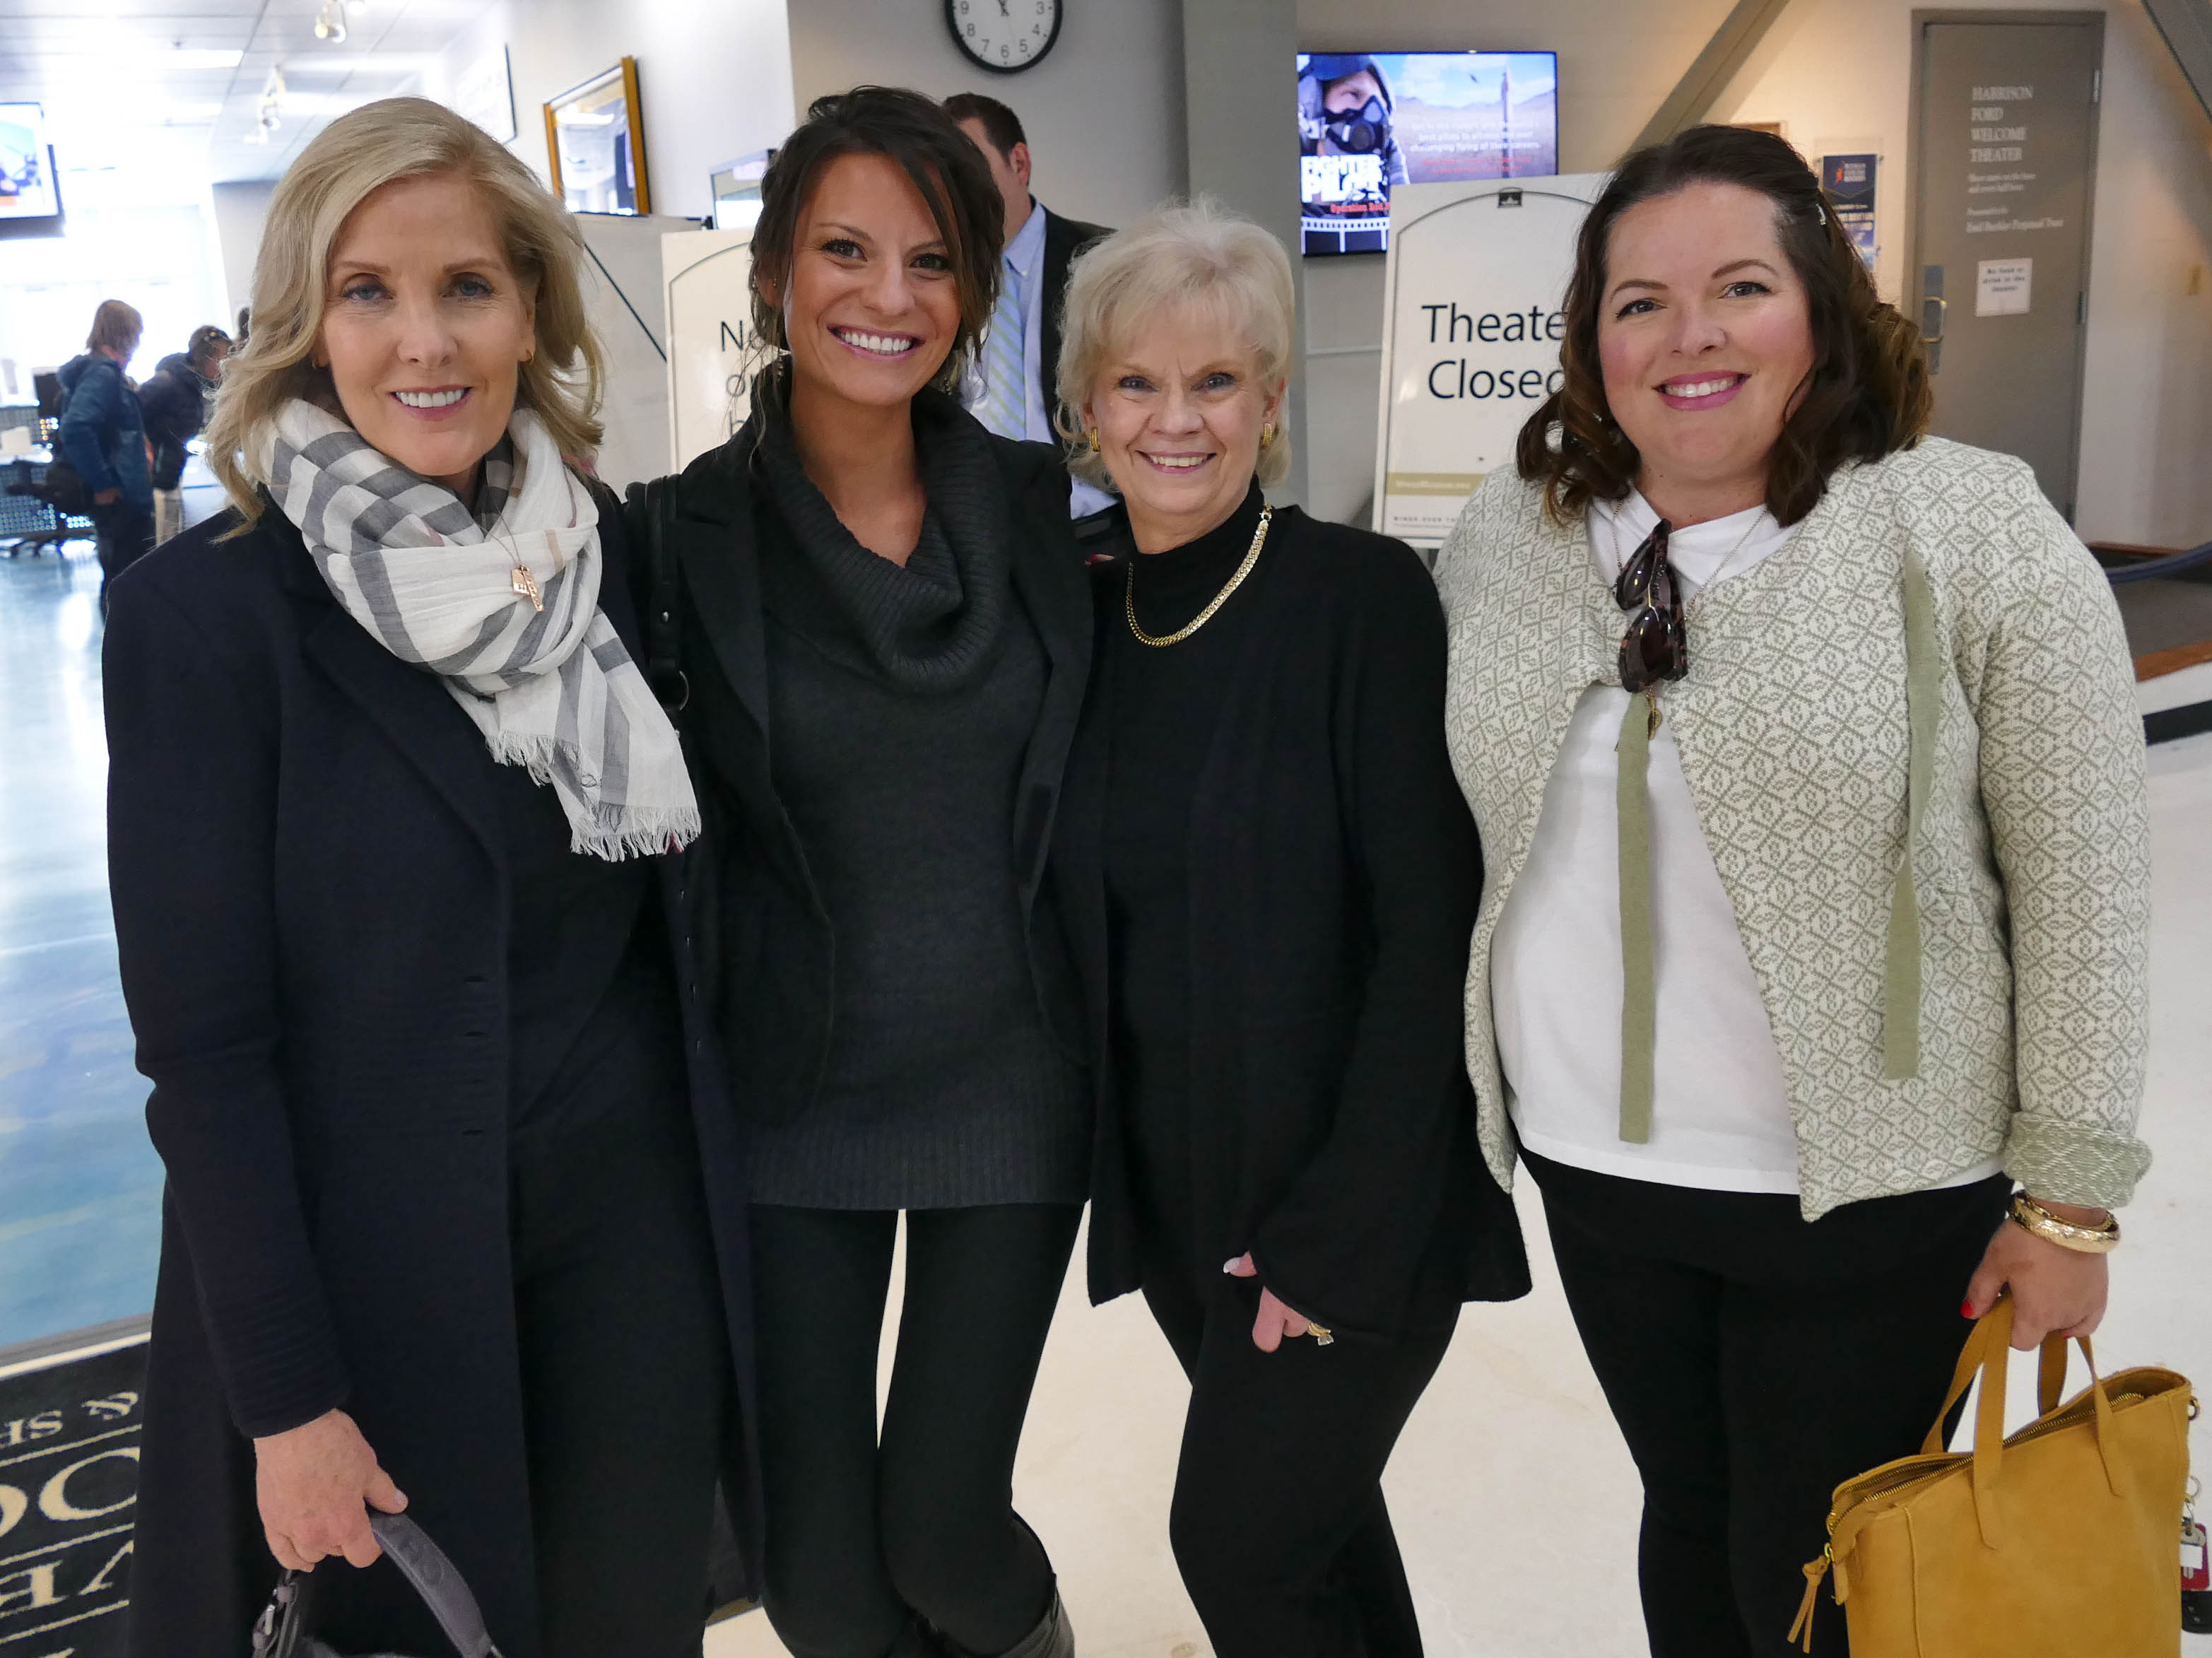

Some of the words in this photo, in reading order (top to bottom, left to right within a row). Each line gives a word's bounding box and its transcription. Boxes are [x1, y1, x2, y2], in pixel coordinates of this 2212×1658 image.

[960, 0, 969, 14] 9
[1036, 1, 1045, 14] 3
[966, 23, 975, 36] 8
[1032, 23, 1040, 35] 4
[982, 39, 989, 52] 7
[1000, 45, 1009, 58] 6
[1019, 39, 1028, 52] 5
[1972, 86, 2033, 101] HARRISON
[1971, 107, 2004, 122] FORD
[1970, 127, 2027, 141] WELCOME
[1970, 146, 2023, 163] THEATER
[1300, 153, 1382, 176] FIGHTER
[1301, 171, 1383, 203] PILOT
[1421, 302, 1567, 343] Theate
[81, 1392, 139, 1420] &
